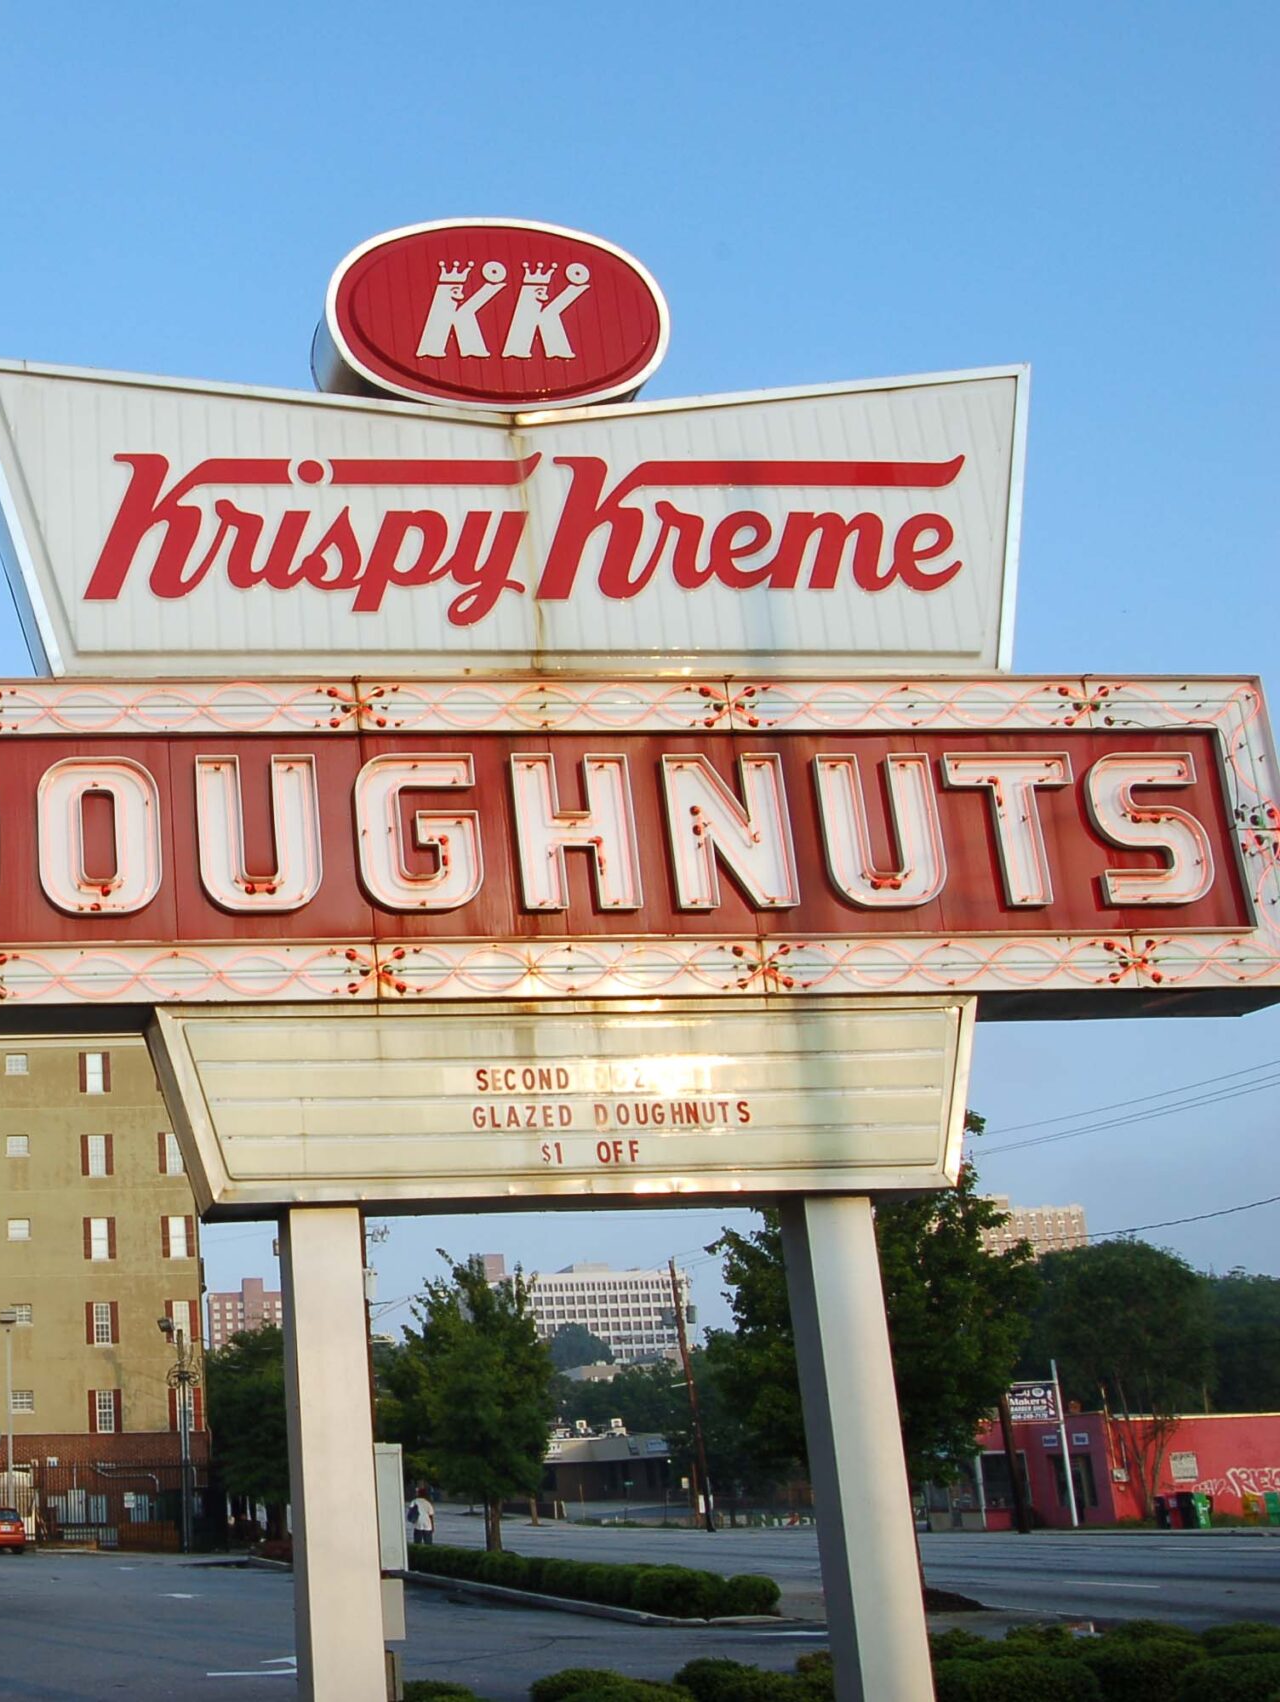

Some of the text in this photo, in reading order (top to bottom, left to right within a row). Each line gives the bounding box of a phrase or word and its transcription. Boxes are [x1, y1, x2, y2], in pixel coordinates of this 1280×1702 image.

[415, 261, 591, 358] KK
[82, 451, 966, 627] Krispy Kreme
[476, 1067, 570, 1092] SECOND
[472, 1101, 751, 1128] GLAZED DOUGHNUTS
[541, 1139, 640, 1164] $1 OFF
